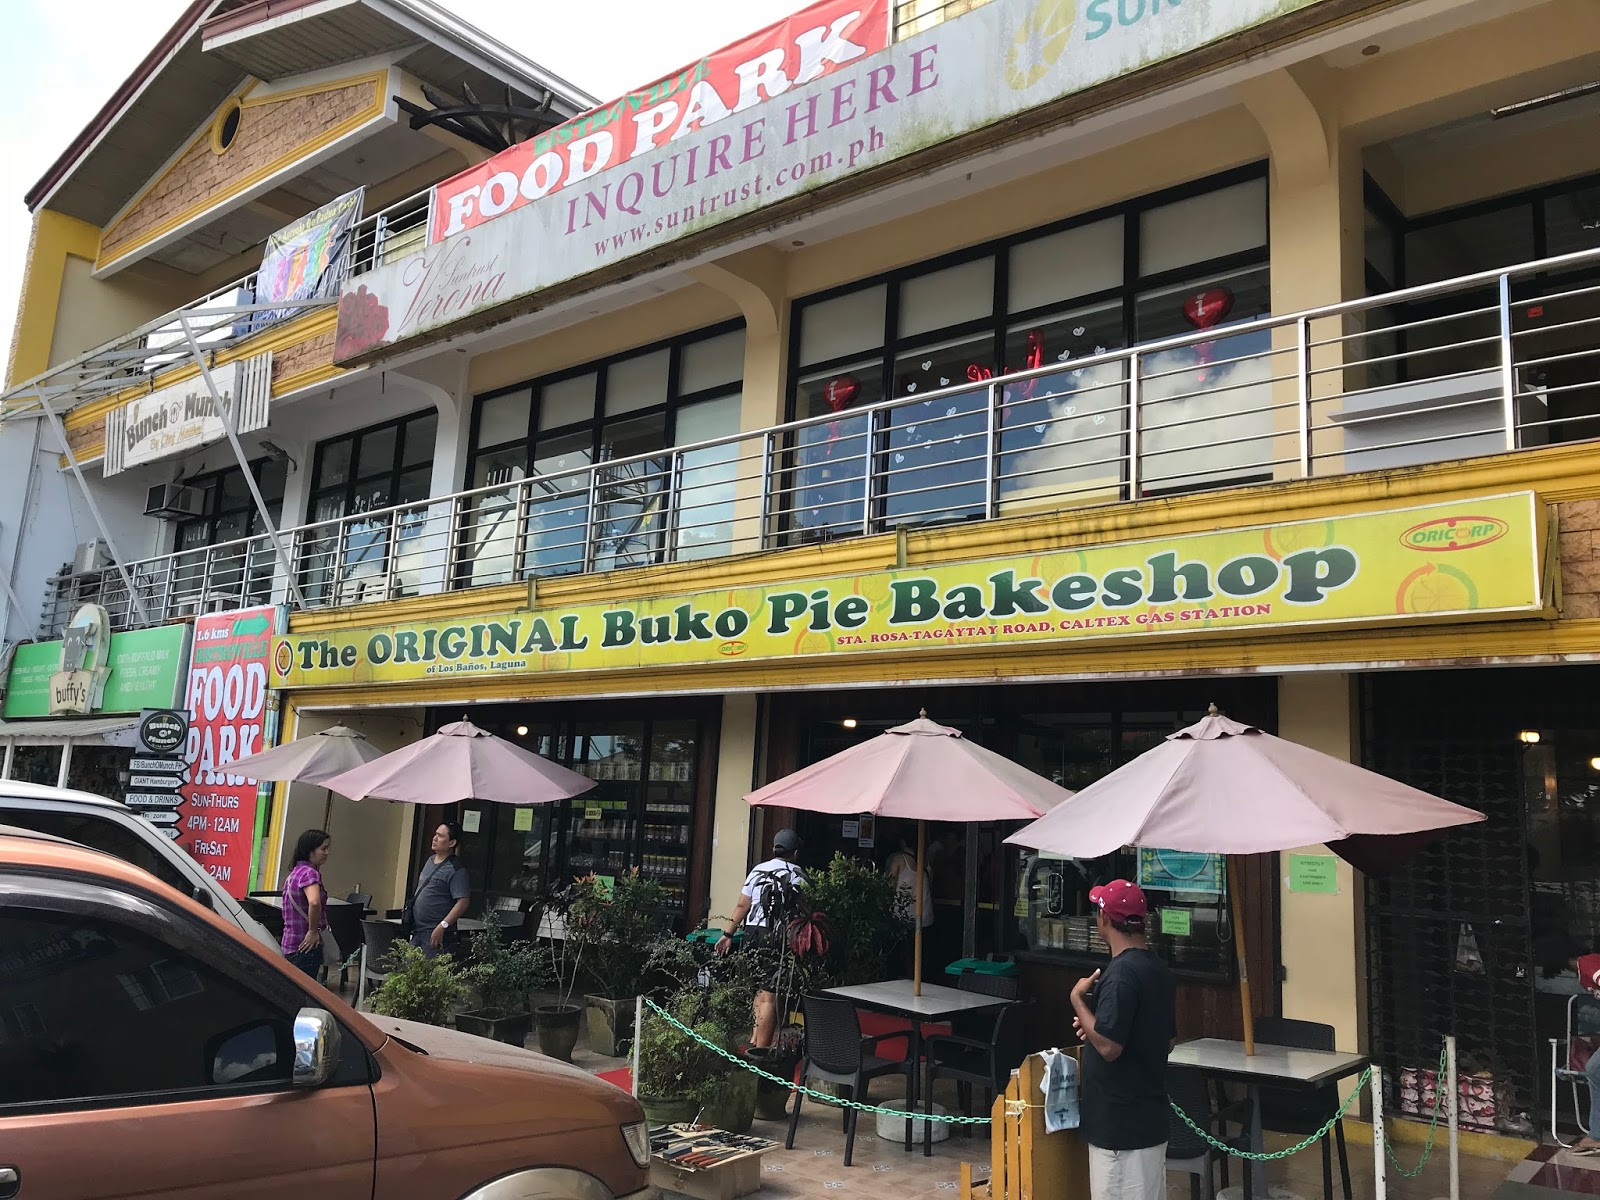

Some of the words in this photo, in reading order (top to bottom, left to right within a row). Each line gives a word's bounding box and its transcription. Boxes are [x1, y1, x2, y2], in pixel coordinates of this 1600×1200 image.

[444, 131, 612, 238] FOOD
[630, 10, 867, 157] PARK
[565, 115, 767, 235] INQUIRE
[783, 44, 940, 146] HERE
[594, 129, 885, 256] www.suntrust.com.ph
[398, 236, 507, 332] Verona
[438, 254, 499, 290] Suntrust
[126, 405, 168, 452] Bunch
[1412, 524, 1495, 544] ORICORP
[299, 639, 356, 670] The
[367, 615, 589, 665] ORIGINAL
[601, 604, 749, 648] Buko
[766, 590, 869, 635] Pie
[890, 546, 1357, 624] Bakeshop
[836, 636, 867, 645] STA.
[870, 625, 998, 643] ROSA-TAGAYTAY
[1003, 621, 1055, 634] ROAD,
[1059, 615, 1131, 630] CALTEX
[1136, 611, 1175, 624] GAS
[1180, 604, 1272, 621] STATION
[197, 631, 209, 641] 1.6
[211, 628, 229, 639] kms
[438, 665, 453, 673] Los
[456, 663, 487, 671] Baños,
[490, 661, 526, 670] Laguna
[56, 683, 86, 706] buffy's
[190, 662, 266, 722] FOOD
[148, 735, 177, 744] Munch
[149, 723, 180, 731] Bunch
[183, 724, 260, 787] PARK
[129, 795, 148, 803] FOOD
[155, 796, 178, 804] DRINKS
[150, 778, 178, 786] Hamburgers
[187, 816, 207, 830] 4PM
[214, 817, 239, 833] 12AM
